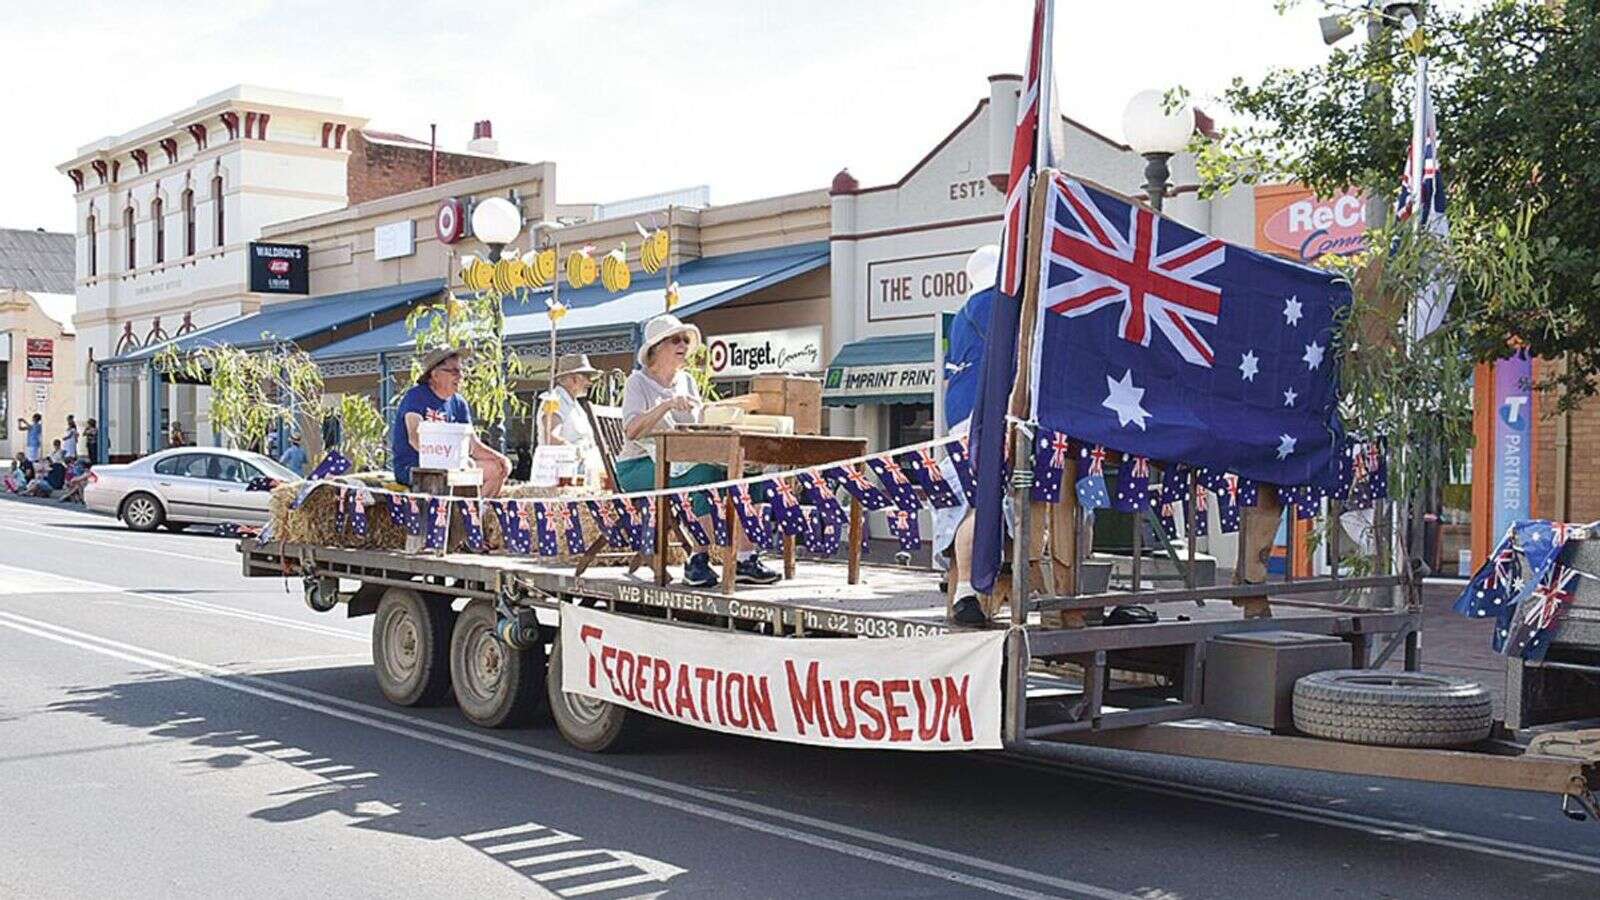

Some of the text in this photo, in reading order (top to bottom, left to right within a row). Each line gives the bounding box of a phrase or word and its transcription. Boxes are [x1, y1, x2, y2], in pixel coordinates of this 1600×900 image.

[880, 271, 973, 302] THE CORO
[845, 371, 898, 389] IMPRINT
[1504, 434, 1520, 510] PARTNER
[618, 585, 641, 602] WB
[644, 588, 703, 611] HUNTER
[580, 624, 973, 743] FEDERATION MUSEUM
